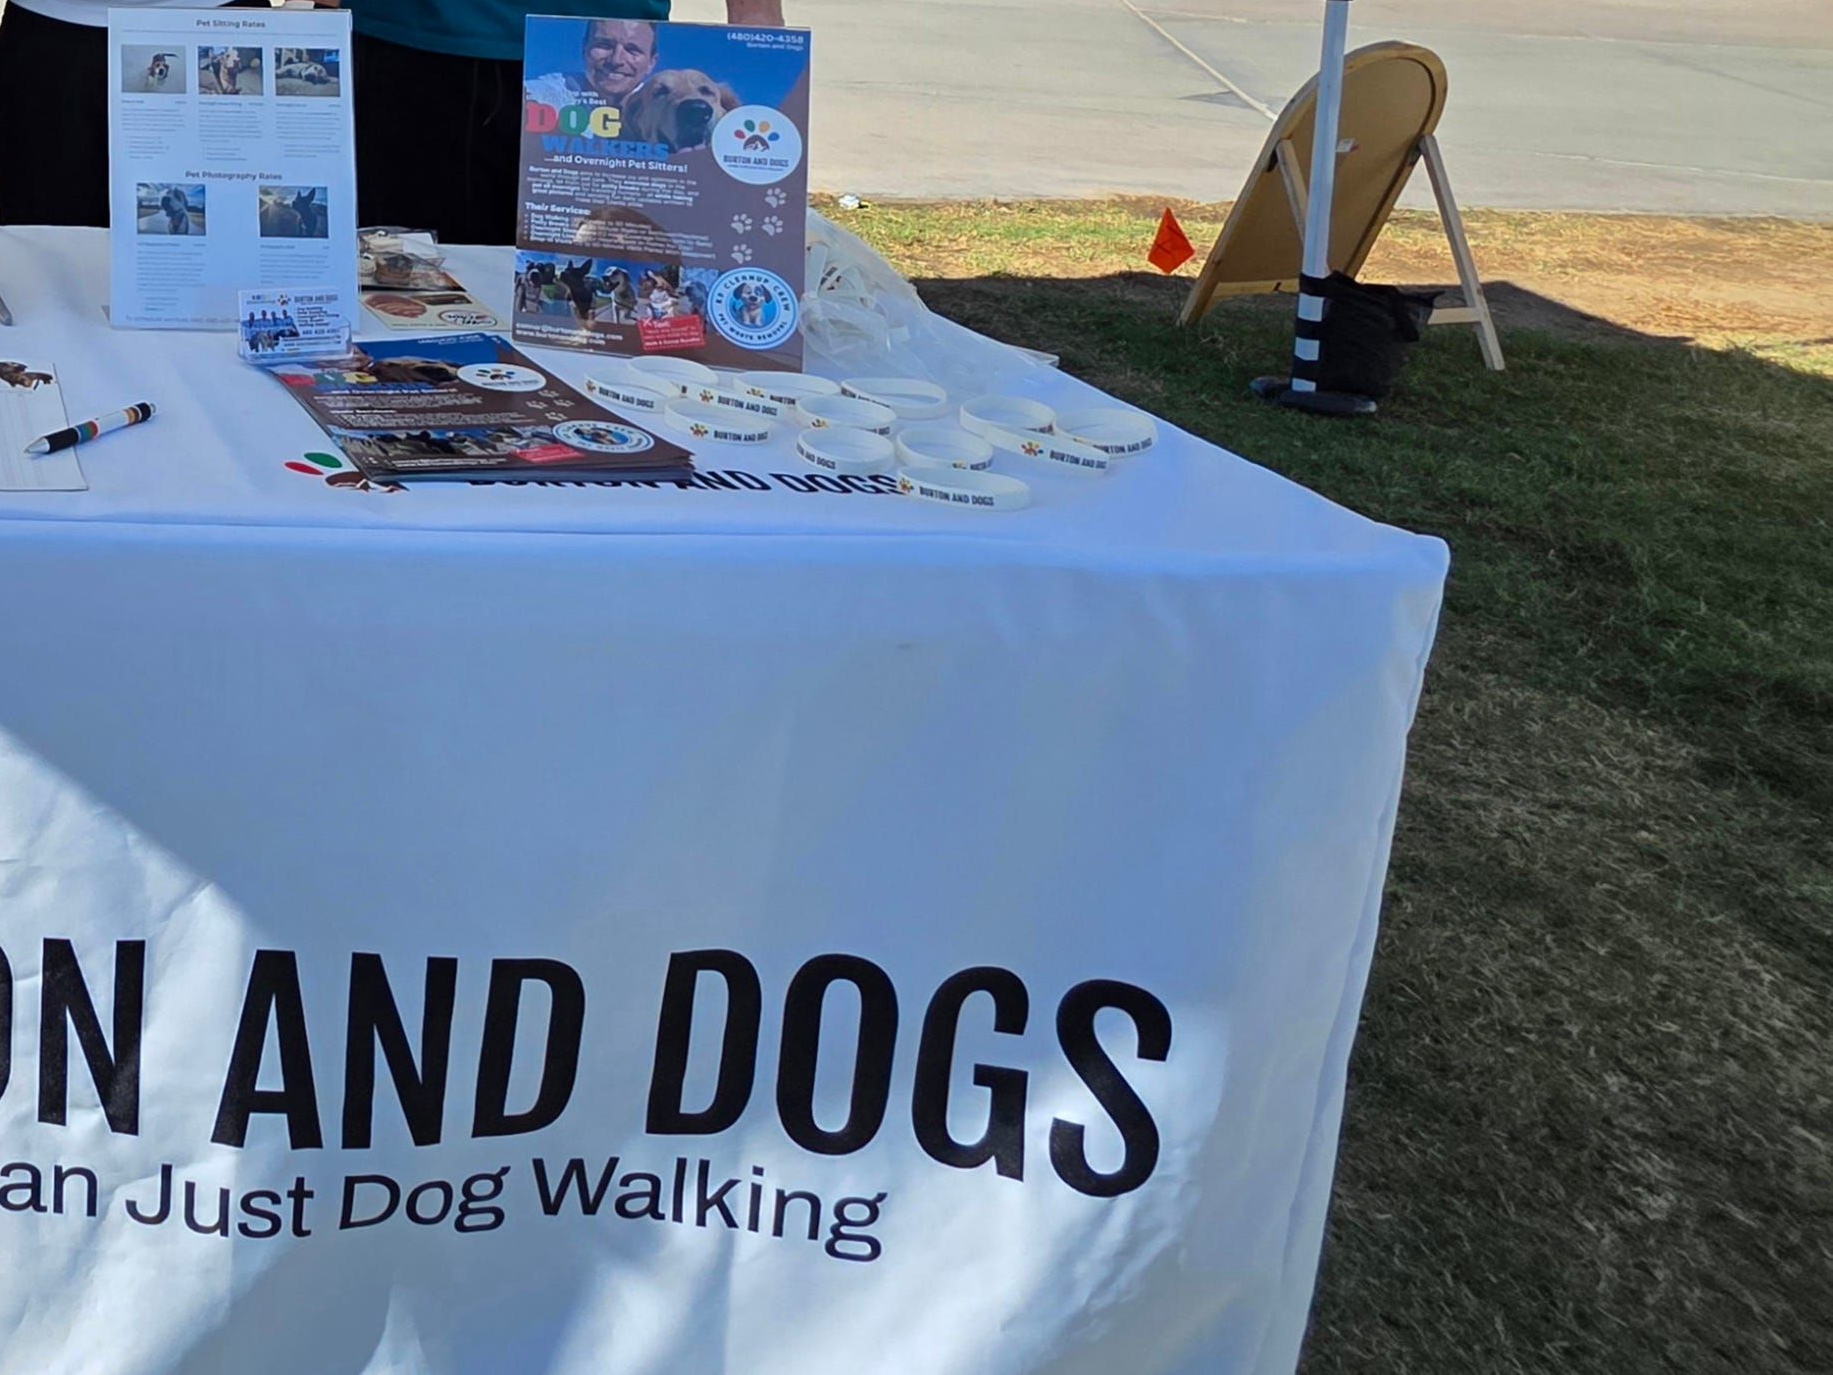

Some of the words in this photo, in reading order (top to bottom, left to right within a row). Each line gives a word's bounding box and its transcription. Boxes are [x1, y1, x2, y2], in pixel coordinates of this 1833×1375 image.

[196, 19, 211, 28] Pet
[212, 19, 240, 29] Sitting
[241, 20, 265, 28] Rates
[524, 100, 622, 138] DOG
[541, 135, 670, 161] WALKERS
[575, 156, 626, 171] Overnight
[628, 160, 646, 170] Pet
[648, 161, 688, 173] Sitters!
[185, 170, 200, 179] Pet
[202, 171, 257, 181] Photography
[259, 172, 282, 181] Rates
[525, 202, 549, 211] Their
[724, 275, 769, 290] CLEANUP
[773, 284, 791, 312] CREW
[598, 386, 620, 400] BURTON
[621, 394, 635, 404] AND
[636, 398, 654, 409] DOGS
[718, 395, 744, 409] BURTON
[745, 402, 760, 413] AND
[761, 406, 778, 416] DOGS
[714, 430, 742, 442] BURTON
[743, 432, 756, 442] AND
[817, 456, 836, 469] DOGS
[1049, 450, 1080, 466] BURTON
[769, 472, 910, 496] DOGS
[919, 486, 950, 502] BURTON
[952, 492, 970, 505] AND
[972, 495, 994, 506] DOGS
[210, 949, 586, 1151] AND
[645, 947, 1173, 1198] DOGS
[125, 1163, 316, 1239] Just
[338, 1164, 509, 1232] Dog
[531, 1156, 886, 1263] Walking
